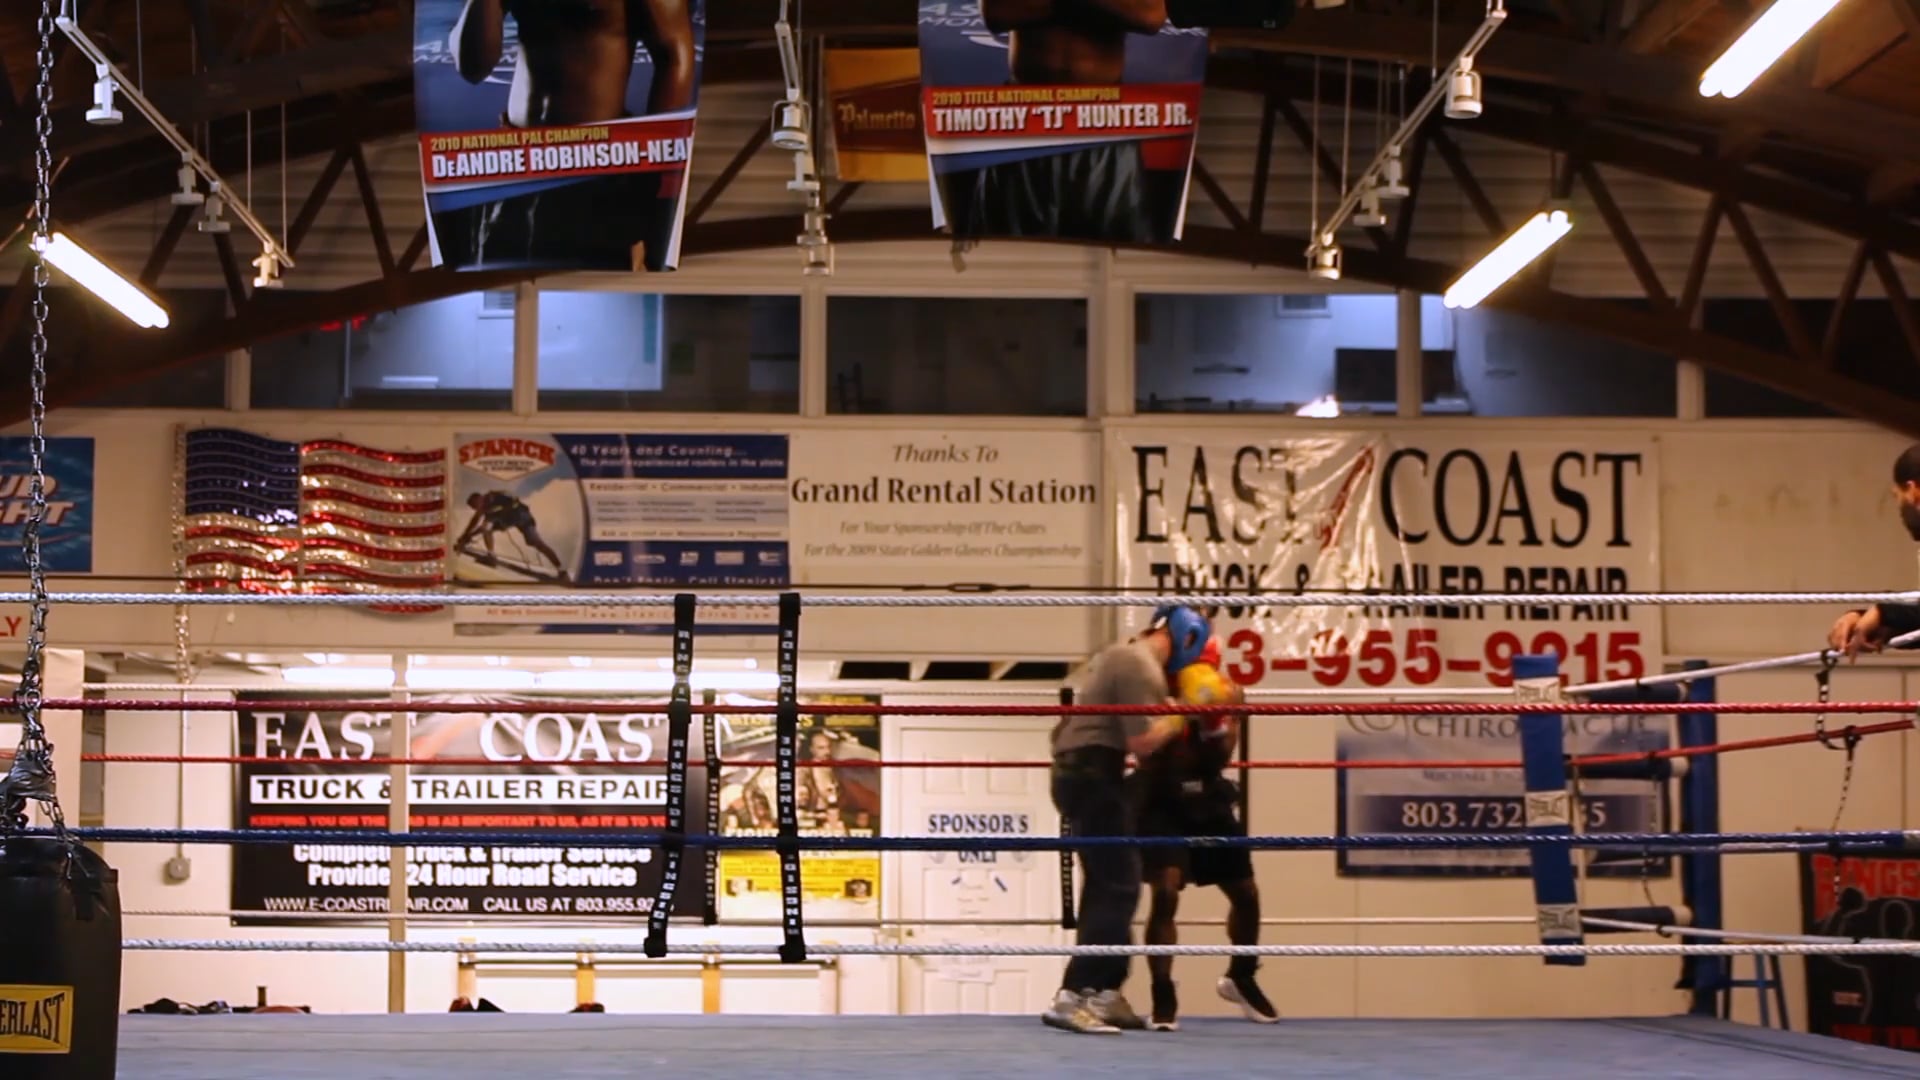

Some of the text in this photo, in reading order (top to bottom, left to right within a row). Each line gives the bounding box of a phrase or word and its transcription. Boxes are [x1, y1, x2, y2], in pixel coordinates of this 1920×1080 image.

[933, 87, 1120, 105] 2010 TITLE NATIONAL CHAMPION
[837, 102, 915, 133] Palmetto
[932, 106, 1028, 132] TIMOTHY
[1077, 103, 1159, 129] HUNTER
[1163, 102, 1193, 127] JR.
[431, 126, 609, 152] 2010 NATIONAL PAL CHAMPION
[458, 437, 555, 466] STANICK
[892, 443, 999, 463] Thanks To
[791, 476, 1097, 504] Grand Rental Station
[1380, 446, 1642, 549] COAST
[1342, 563, 1484, 619] AILER
[1504, 566, 1630, 621] REPAIR
[250, 711, 416, 761] EAS
[257, 778, 364, 800] TRUCK
[412, 778, 543, 800] TRAILER
[308, 863, 638, 887] Provide 24 Hour Road Service
[482, 897, 521, 912] CALL
[525, 897, 547, 912] US
[551, 897, 571, 912] AT
